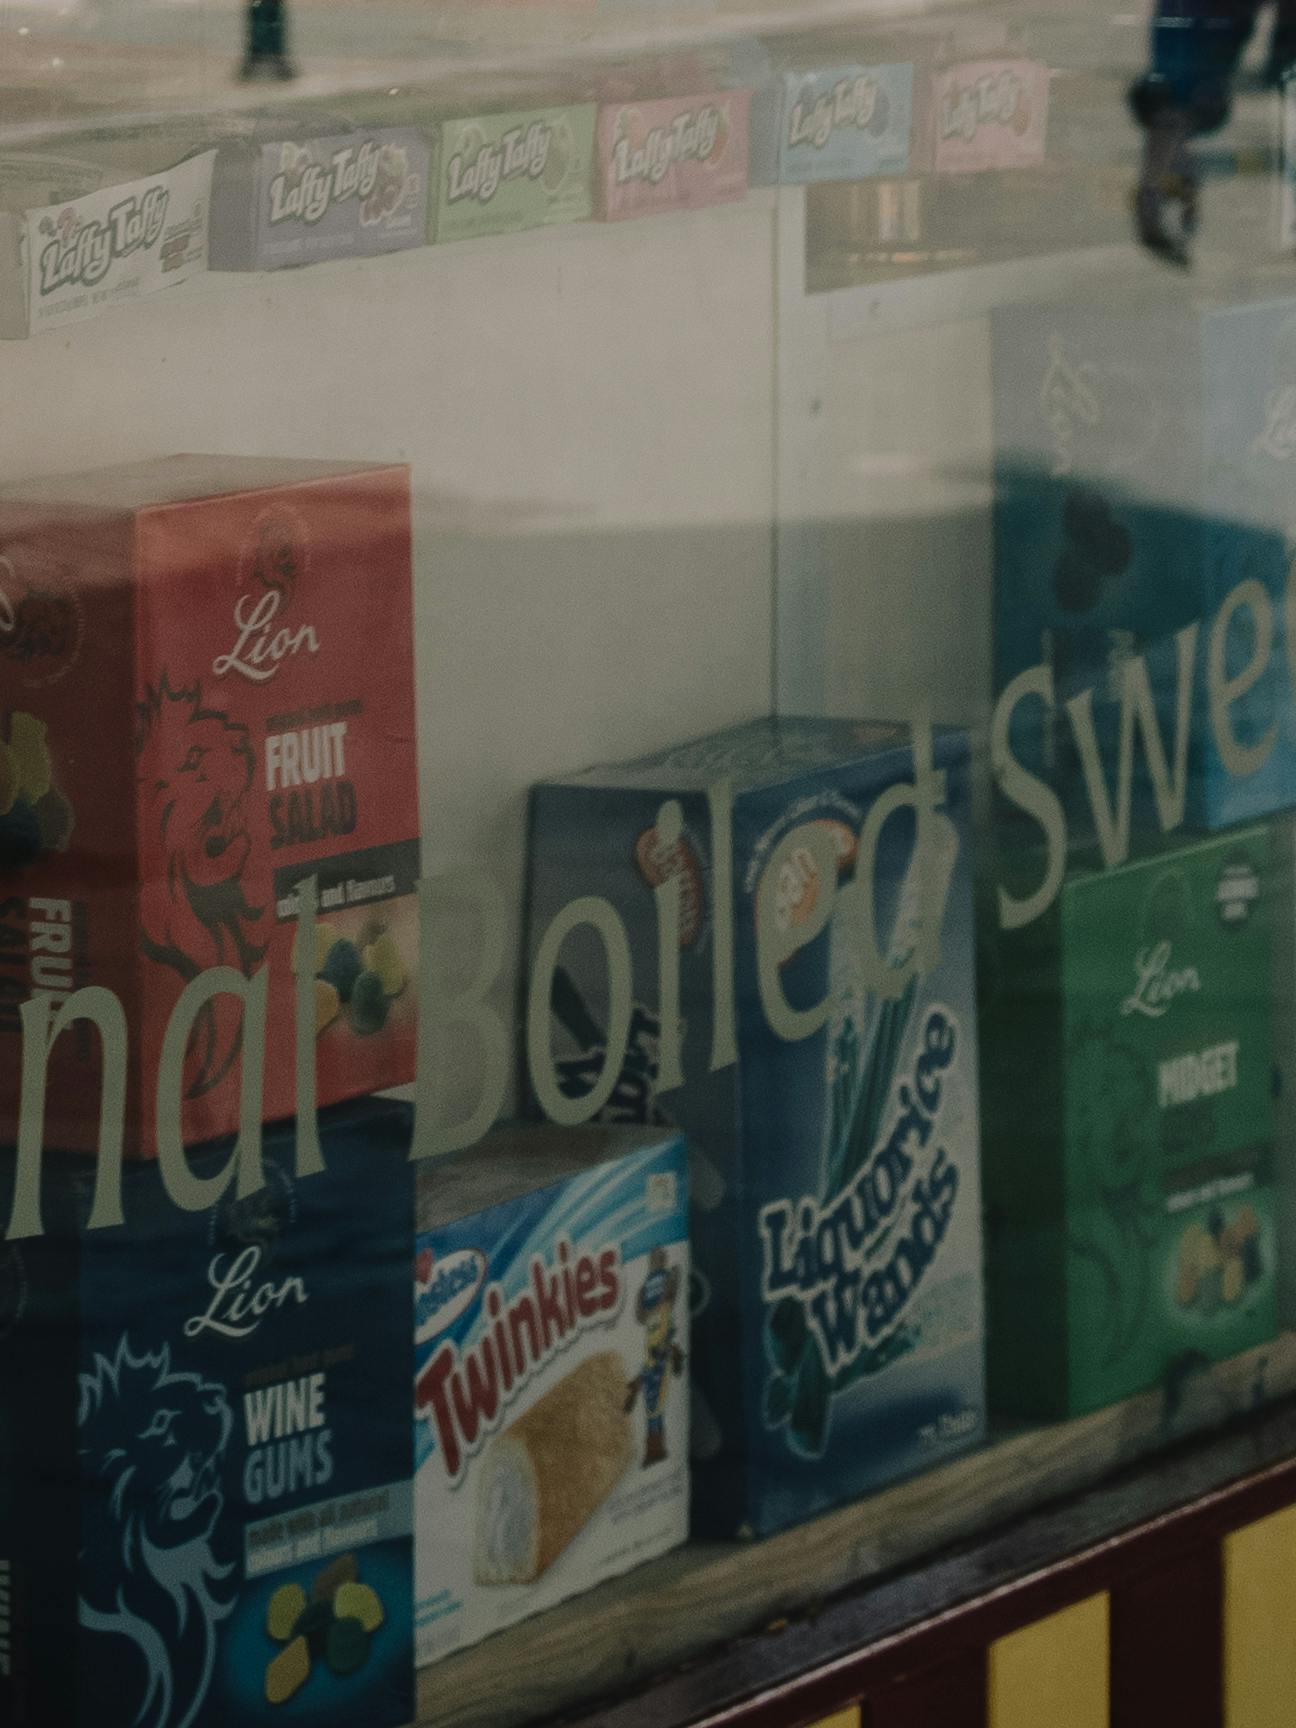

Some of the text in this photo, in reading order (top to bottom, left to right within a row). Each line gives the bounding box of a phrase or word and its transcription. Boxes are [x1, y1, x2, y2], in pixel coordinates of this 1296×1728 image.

[270, 142, 382, 224] Laffy Taffy
[445, 119, 554, 203] Laffy Taffy
[615, 105, 718, 186] Laffy Taffy
[38, 185, 171, 296] Laffy Taffy
[212, 589, 320, 683] Lion
[264, 721, 348, 793] FRUIT
[992, 556, 1296, 933] Swe
[269, 780, 357, 849] SALAD
[1120, 940, 1203, 1019] Lion
[1157, 1042, 1240, 1108] MIDGET
[764, 1010, 957, 1294] Liquorice
[183, 1246, 311, 1340] Lion
[414, 1237, 622, 1480] Twinkies
[243, 1370, 327, 1446] WINE
[243, 1428, 335, 1505] GUMS
